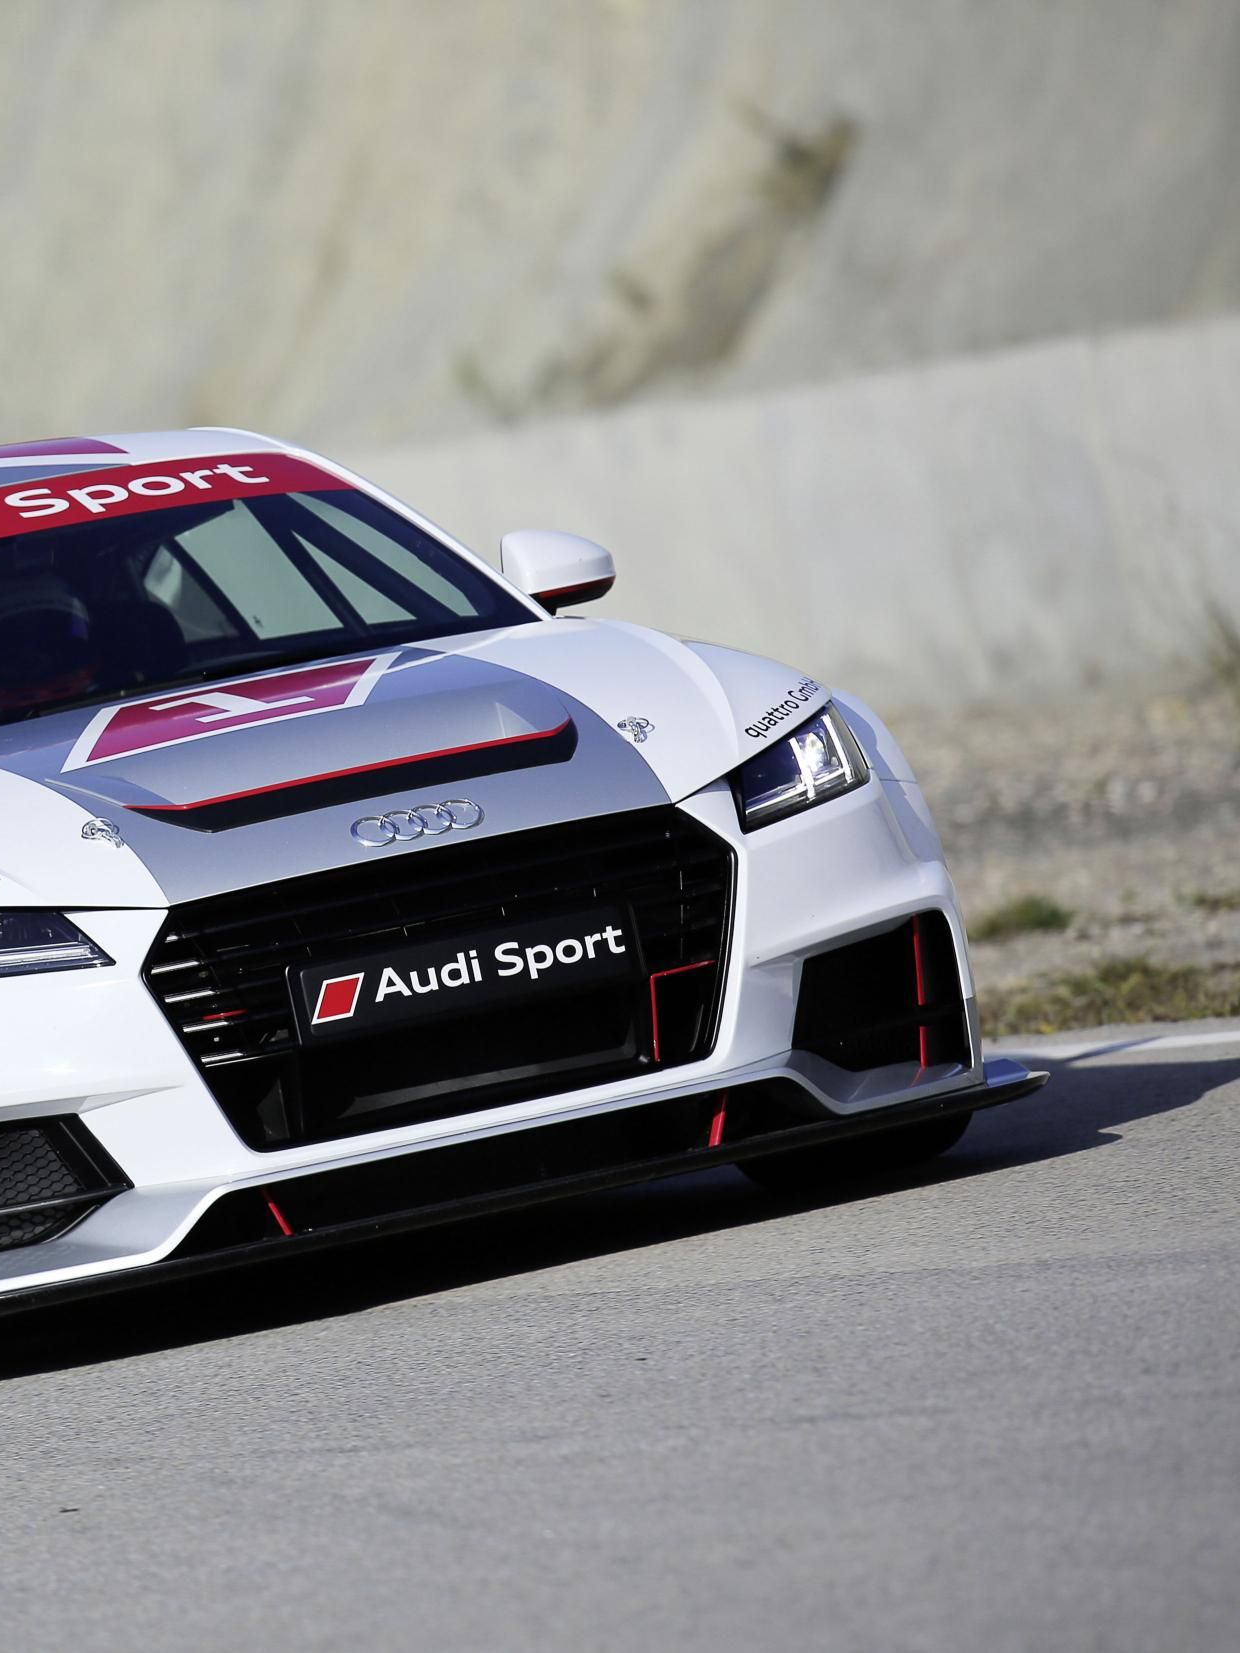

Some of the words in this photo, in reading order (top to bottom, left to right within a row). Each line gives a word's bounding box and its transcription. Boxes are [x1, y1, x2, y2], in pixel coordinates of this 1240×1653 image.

[3, 461, 271, 519] Sport
[744, 699, 800, 739] quattro
[375, 948, 482, 1004] Audi
[493, 924, 626, 980] Sport
